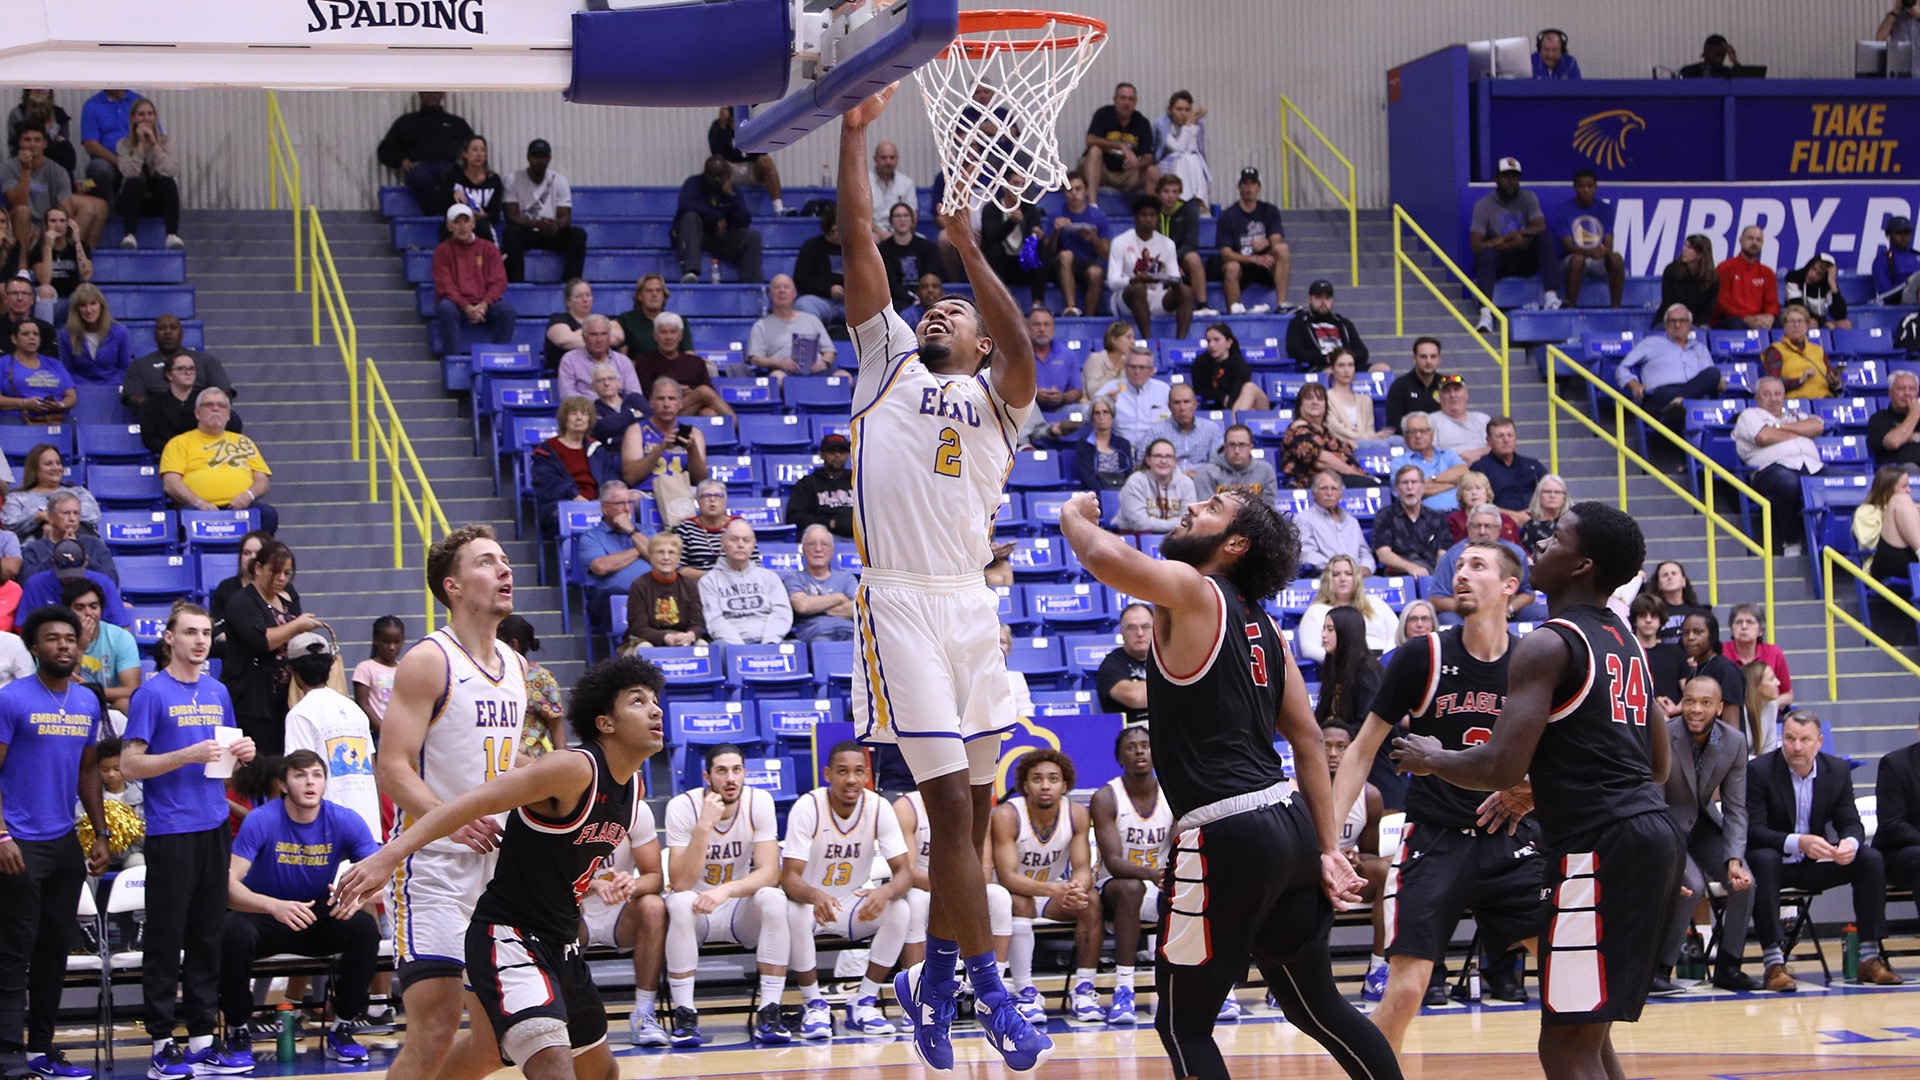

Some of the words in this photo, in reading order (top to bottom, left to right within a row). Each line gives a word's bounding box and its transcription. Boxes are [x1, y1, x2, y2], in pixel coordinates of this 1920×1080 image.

[308, 0, 484, 34] SPALDING
[1811, 104, 1887, 137] TAKE
[1790, 140, 1901, 173] FLIGHT.
[1602, 197, 1920, 277] MBRY-R
[919, 387, 981, 428] ERAU
[934, 426, 962, 478] 2
[1605, 653, 1648, 726] 24
[168, 705, 224, 718] EMBRY-RIDDLE
[475, 700, 517, 727] ERAU
[1435, 691, 1508, 718] FLAGL
[30, 713, 92, 727] EMBRY-RIDDLE
[37, 724, 89, 737] BASKETBALL
[177, 715, 223, 727] BASKETBALL
[484, 736, 512, 783] 14
[1126, 827, 1167, 844] ERAU
[277, 853, 329, 867] BASKETBALL
[1020, 850, 1062, 867] ERAU
[703, 863, 734, 886] 31
[822, 861, 853, 886] 13
